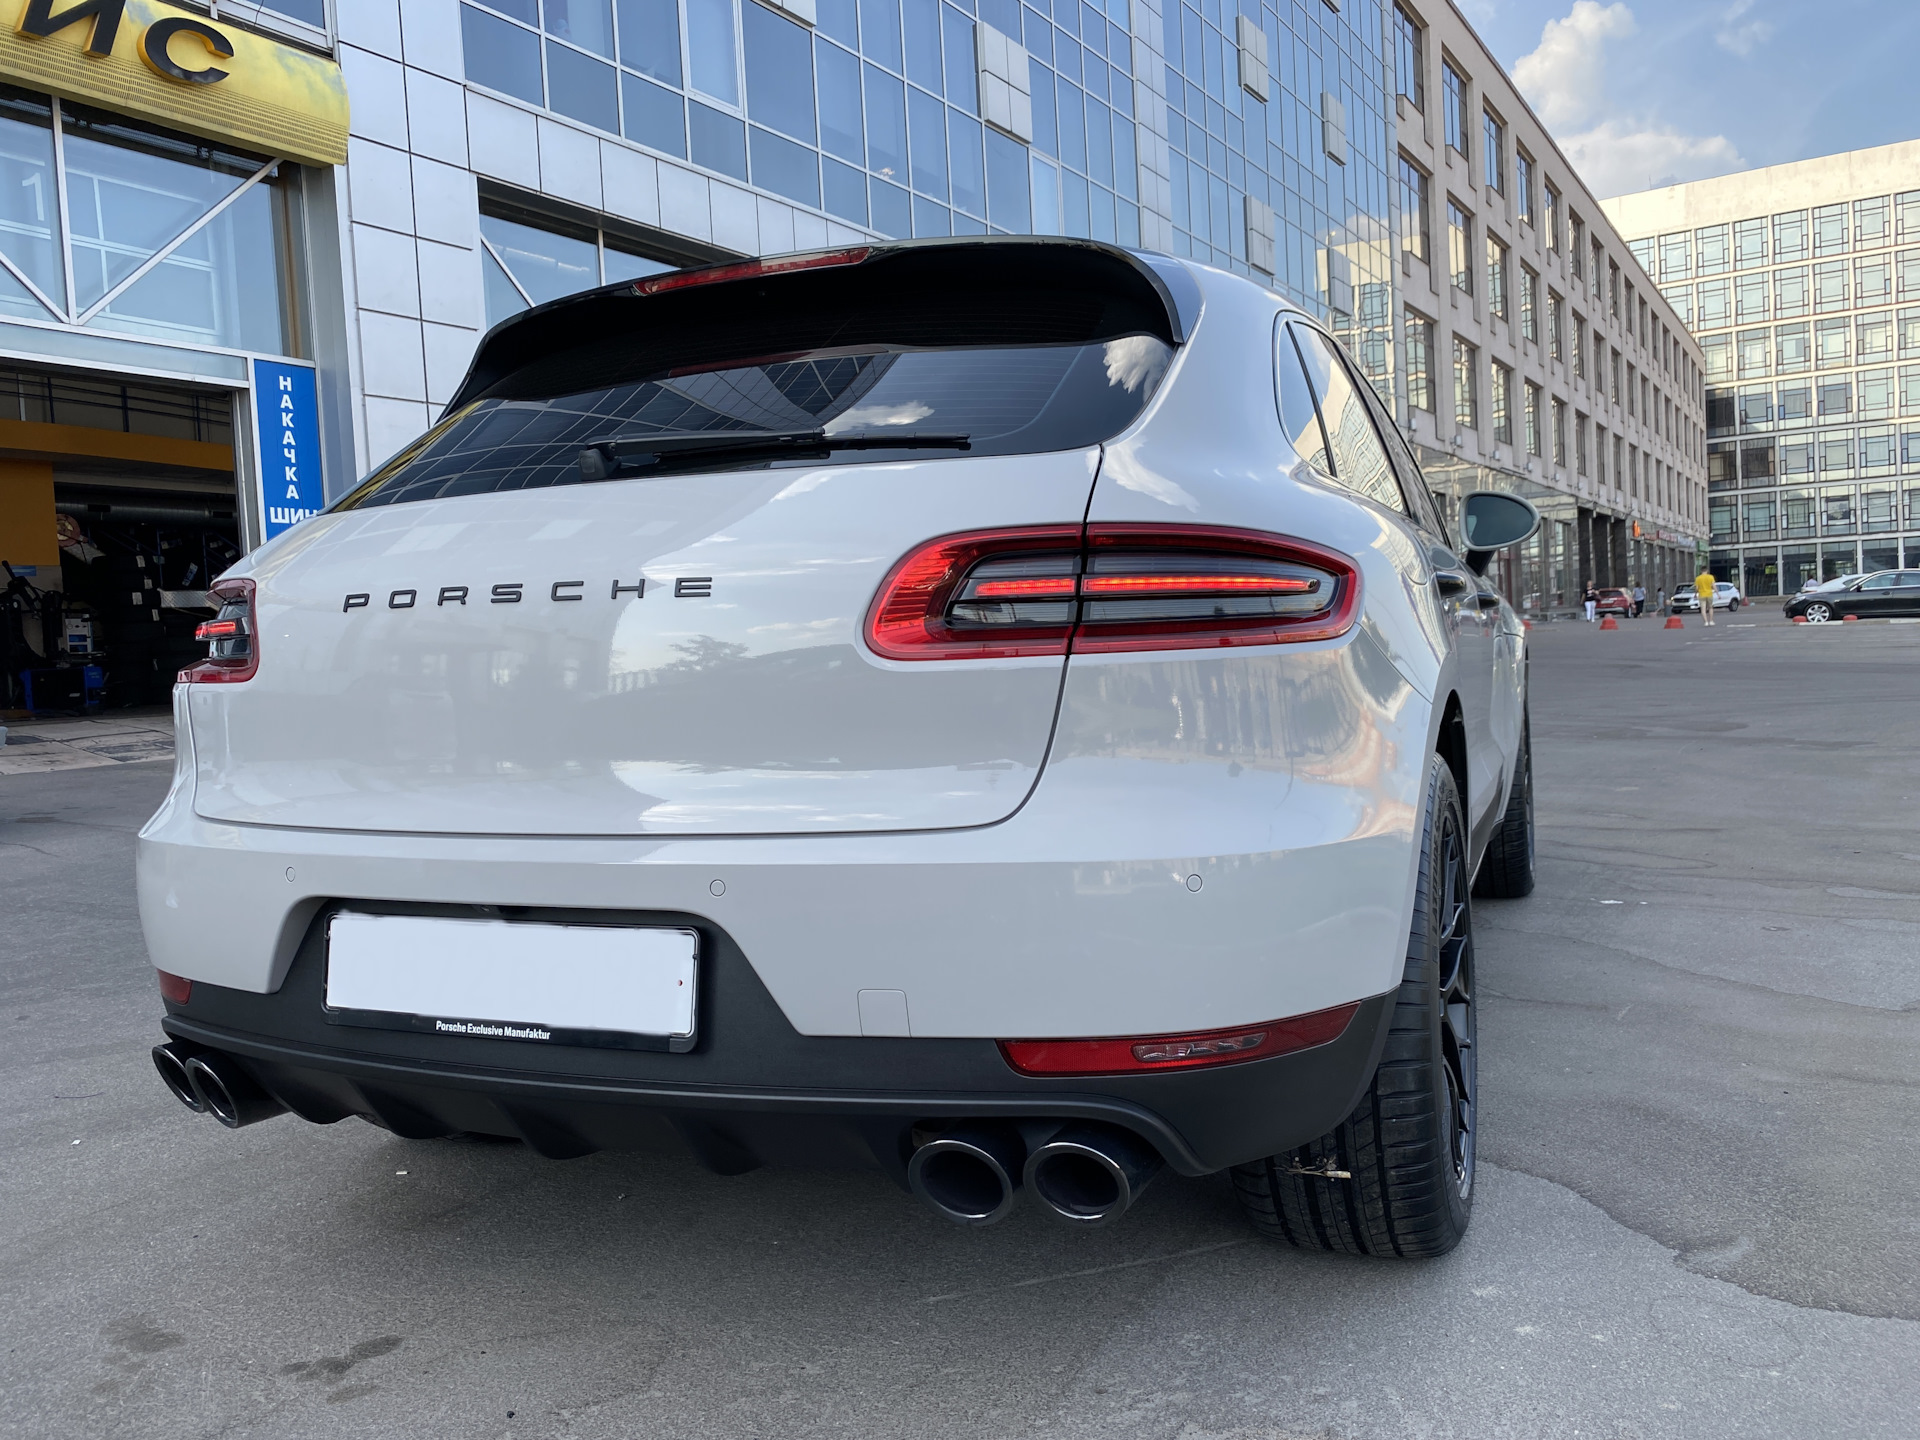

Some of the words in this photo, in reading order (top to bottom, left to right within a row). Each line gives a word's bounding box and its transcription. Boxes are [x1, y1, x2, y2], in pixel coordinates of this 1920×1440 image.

[22, 172, 45, 222] 1
[278, 375, 300, 500] НАКАЧКА
[343, 576, 713, 613] PORSCHE
[435, 1020, 466, 1033] Porsche
[467, 1023, 503, 1036] Exclusive
[504, 1026, 551, 1040] Manufaktur
